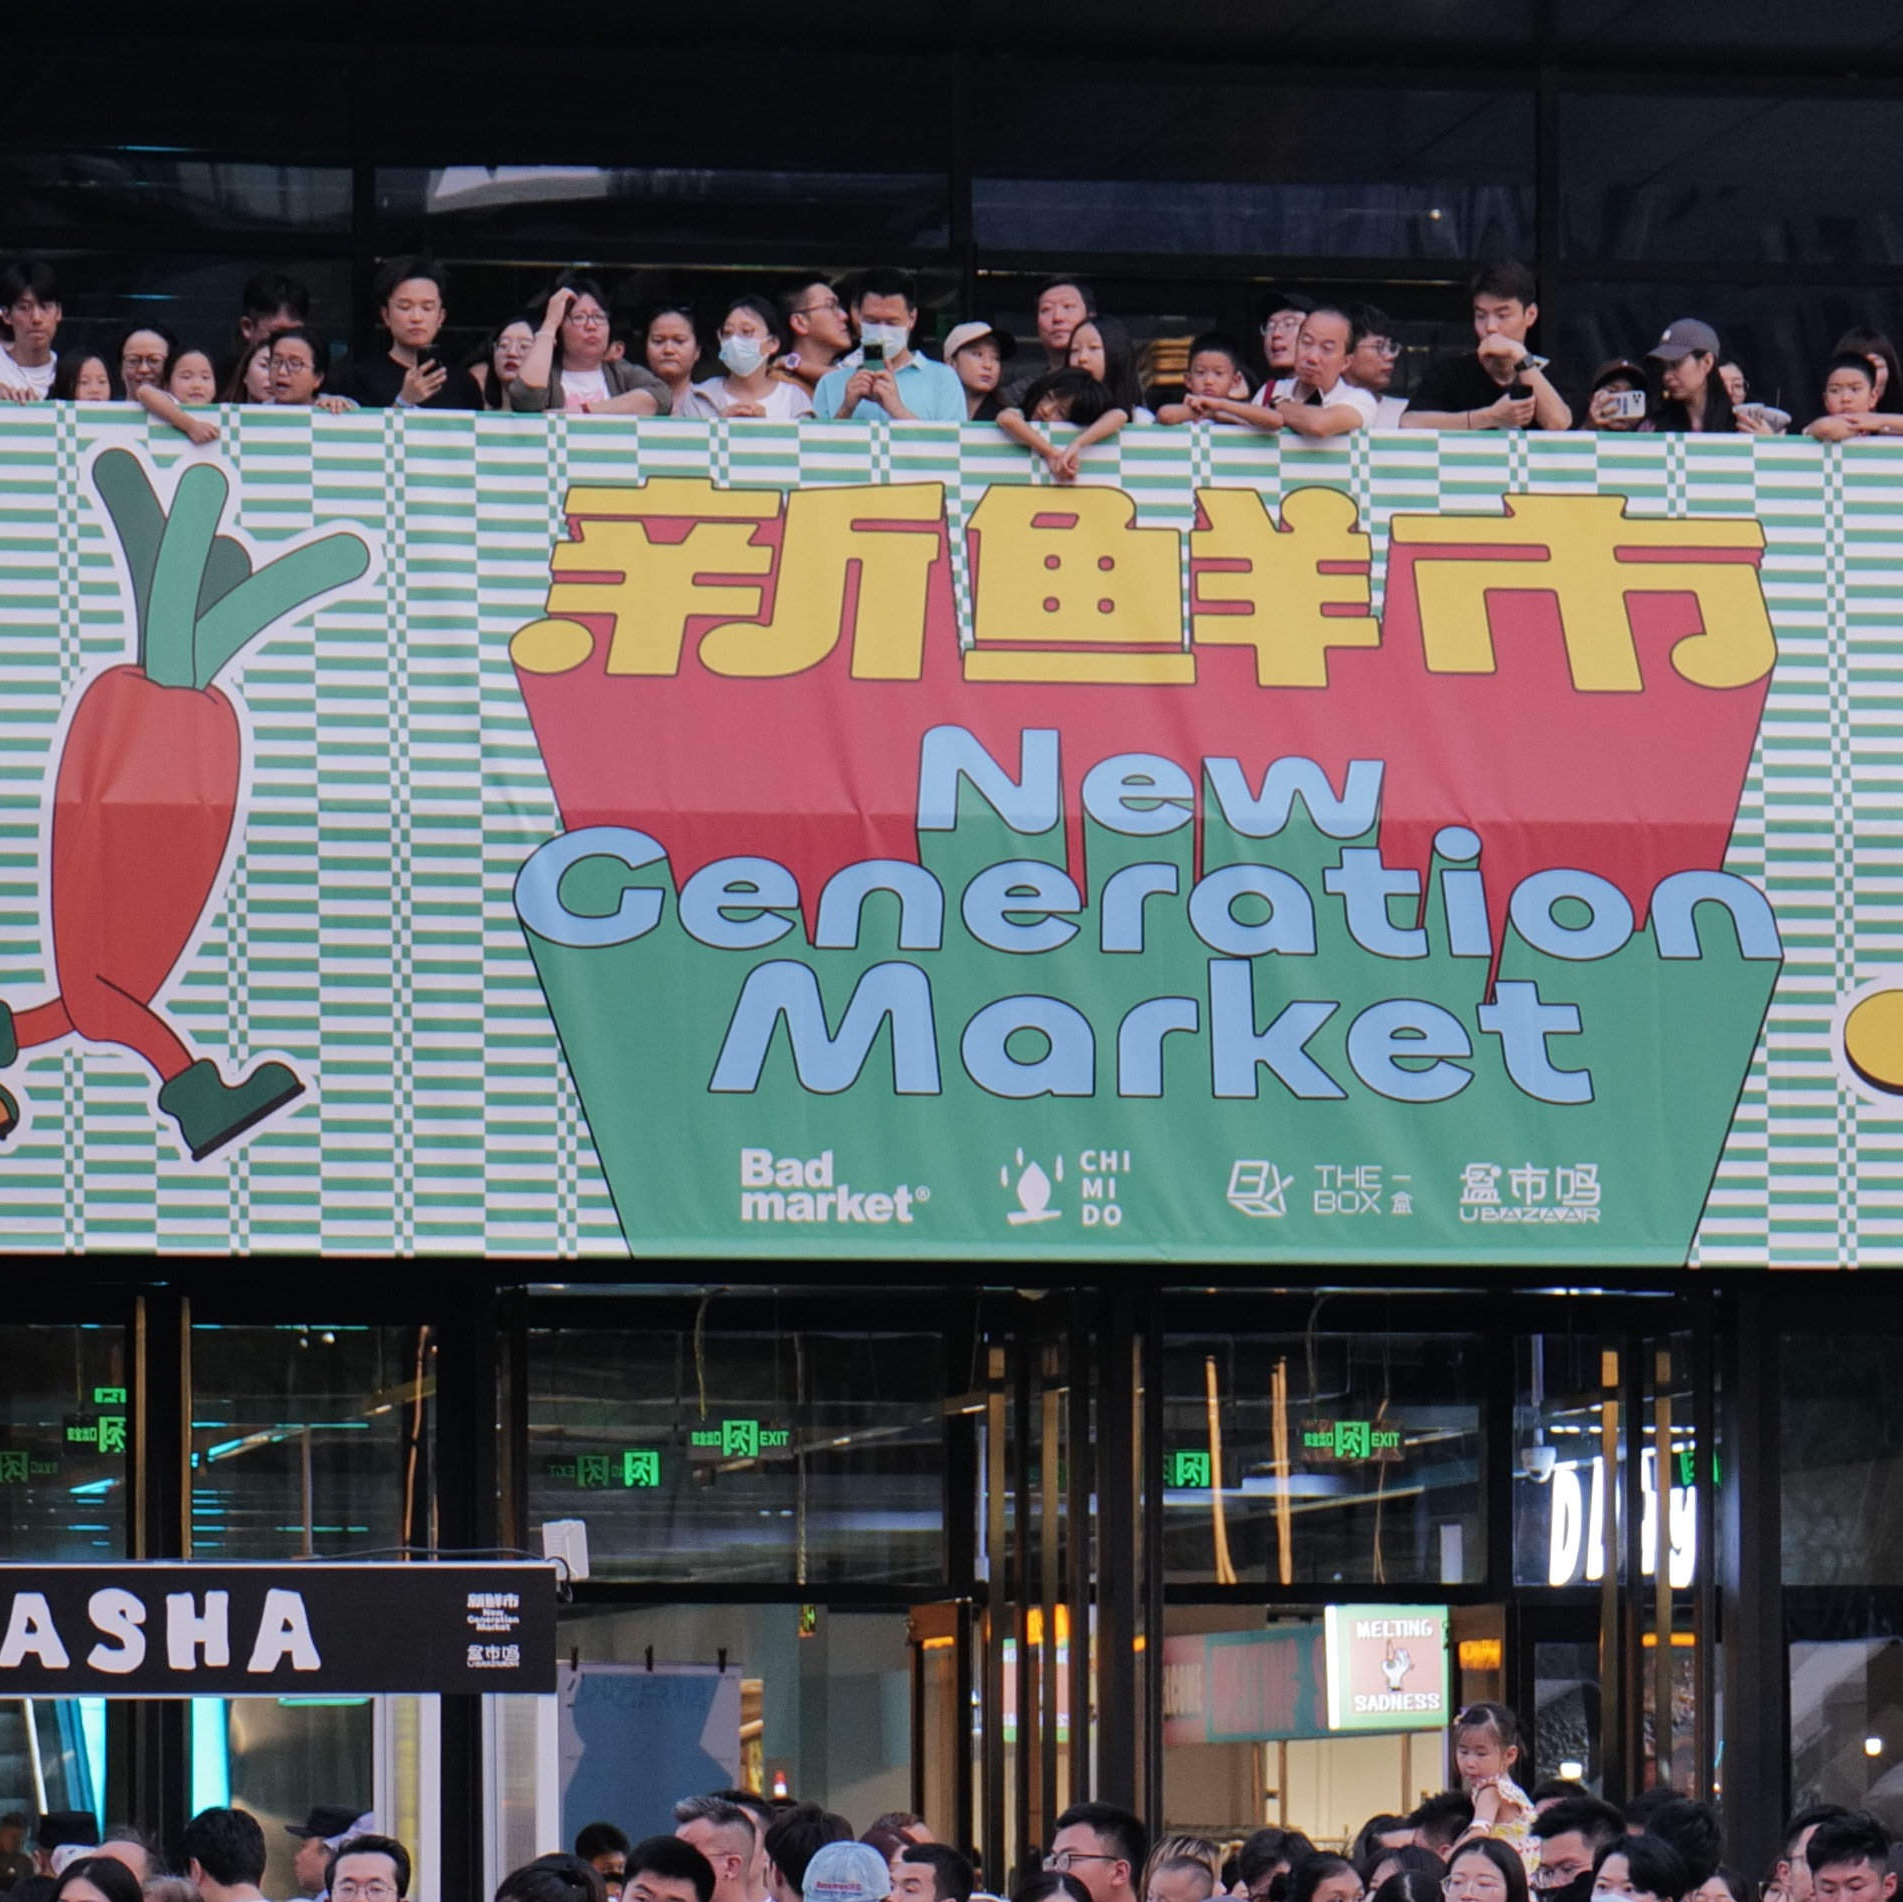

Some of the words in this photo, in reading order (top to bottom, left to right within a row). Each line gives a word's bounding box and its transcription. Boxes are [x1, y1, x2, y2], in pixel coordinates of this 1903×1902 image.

[507, 475, 1780, 694] 新鲜市
[914, 724, 1386, 839] New
[513, 824, 1785, 963] Generation
[707, 957, 1596, 1107] Market
[740, 1148, 834, 1189] Bad
[1079, 1149, 1132, 1173] CHI
[1314, 1164, 1383, 1188] THE
[1080, 1177, 1118, 1200] MI
[1314, 1190, 1382, 1215] BOX
[1081, 1204, 1123, 1227] DO
[760, 1431, 789, 1446] EXIT
[1371, 1432, 1400, 1447] EXIT
[1355, 1618, 1434, 1638] MELTING
[1353, 1692, 1442, 1713] SADNESS
